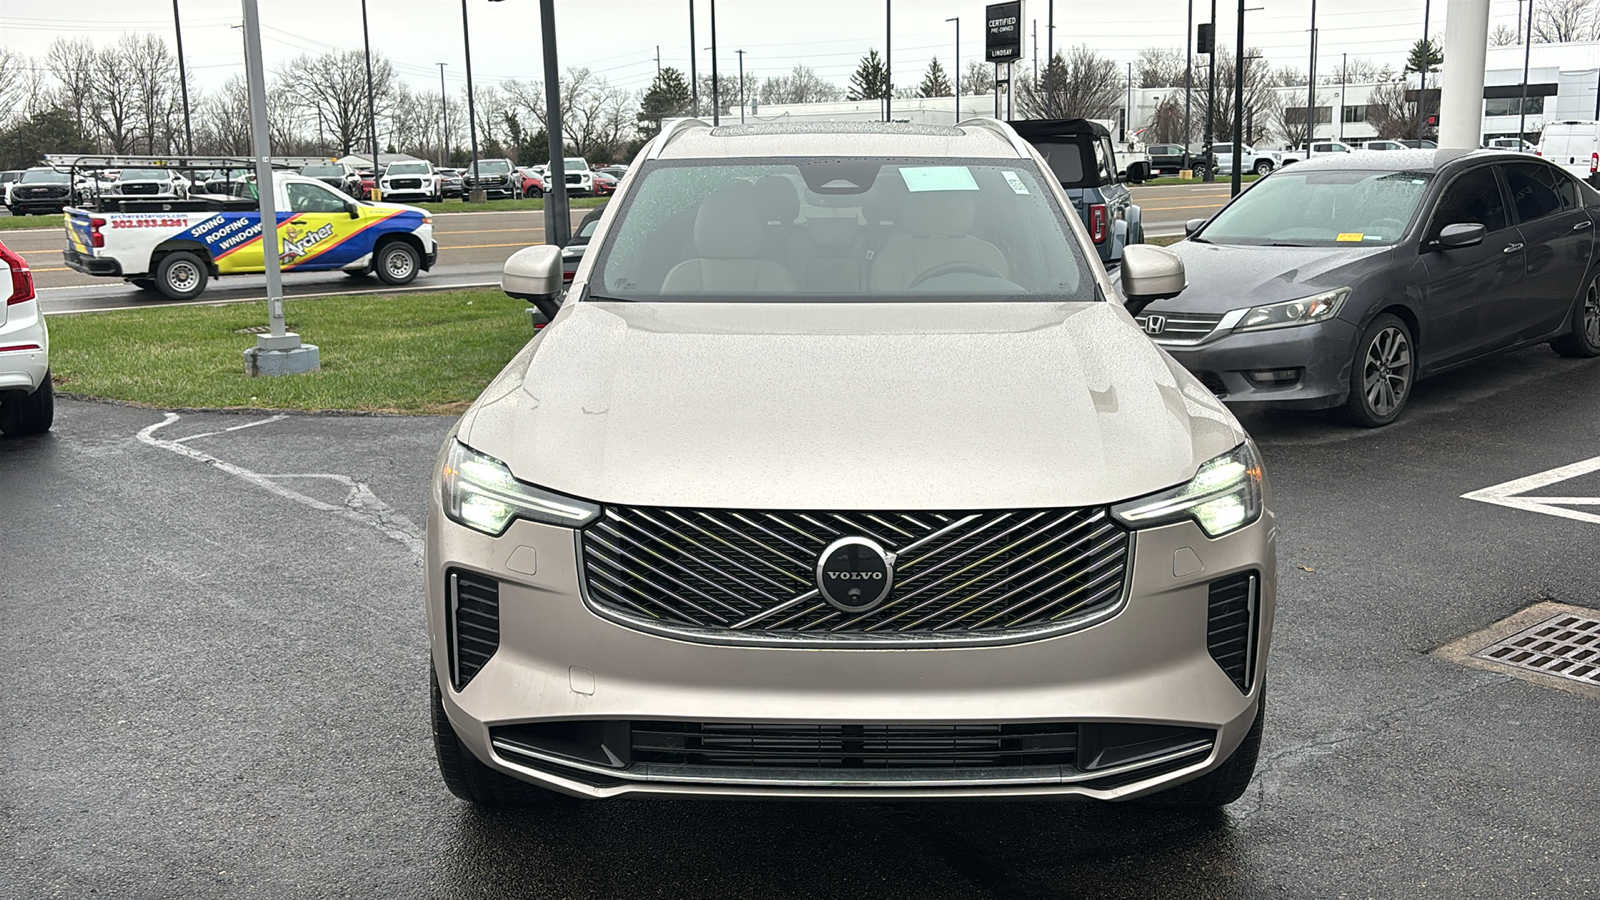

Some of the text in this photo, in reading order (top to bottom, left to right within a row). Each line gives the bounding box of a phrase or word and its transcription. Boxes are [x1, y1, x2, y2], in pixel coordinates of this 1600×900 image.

[988, 17, 1016, 27] CERTIFIED
[991, 48, 1013, 58] LINDSAY
[191, 215, 225, 237] SIDING
[204, 216, 250, 244] ROOFING
[282, 223, 333, 264] Archer
[827, 571, 883, 580] VOLVO
